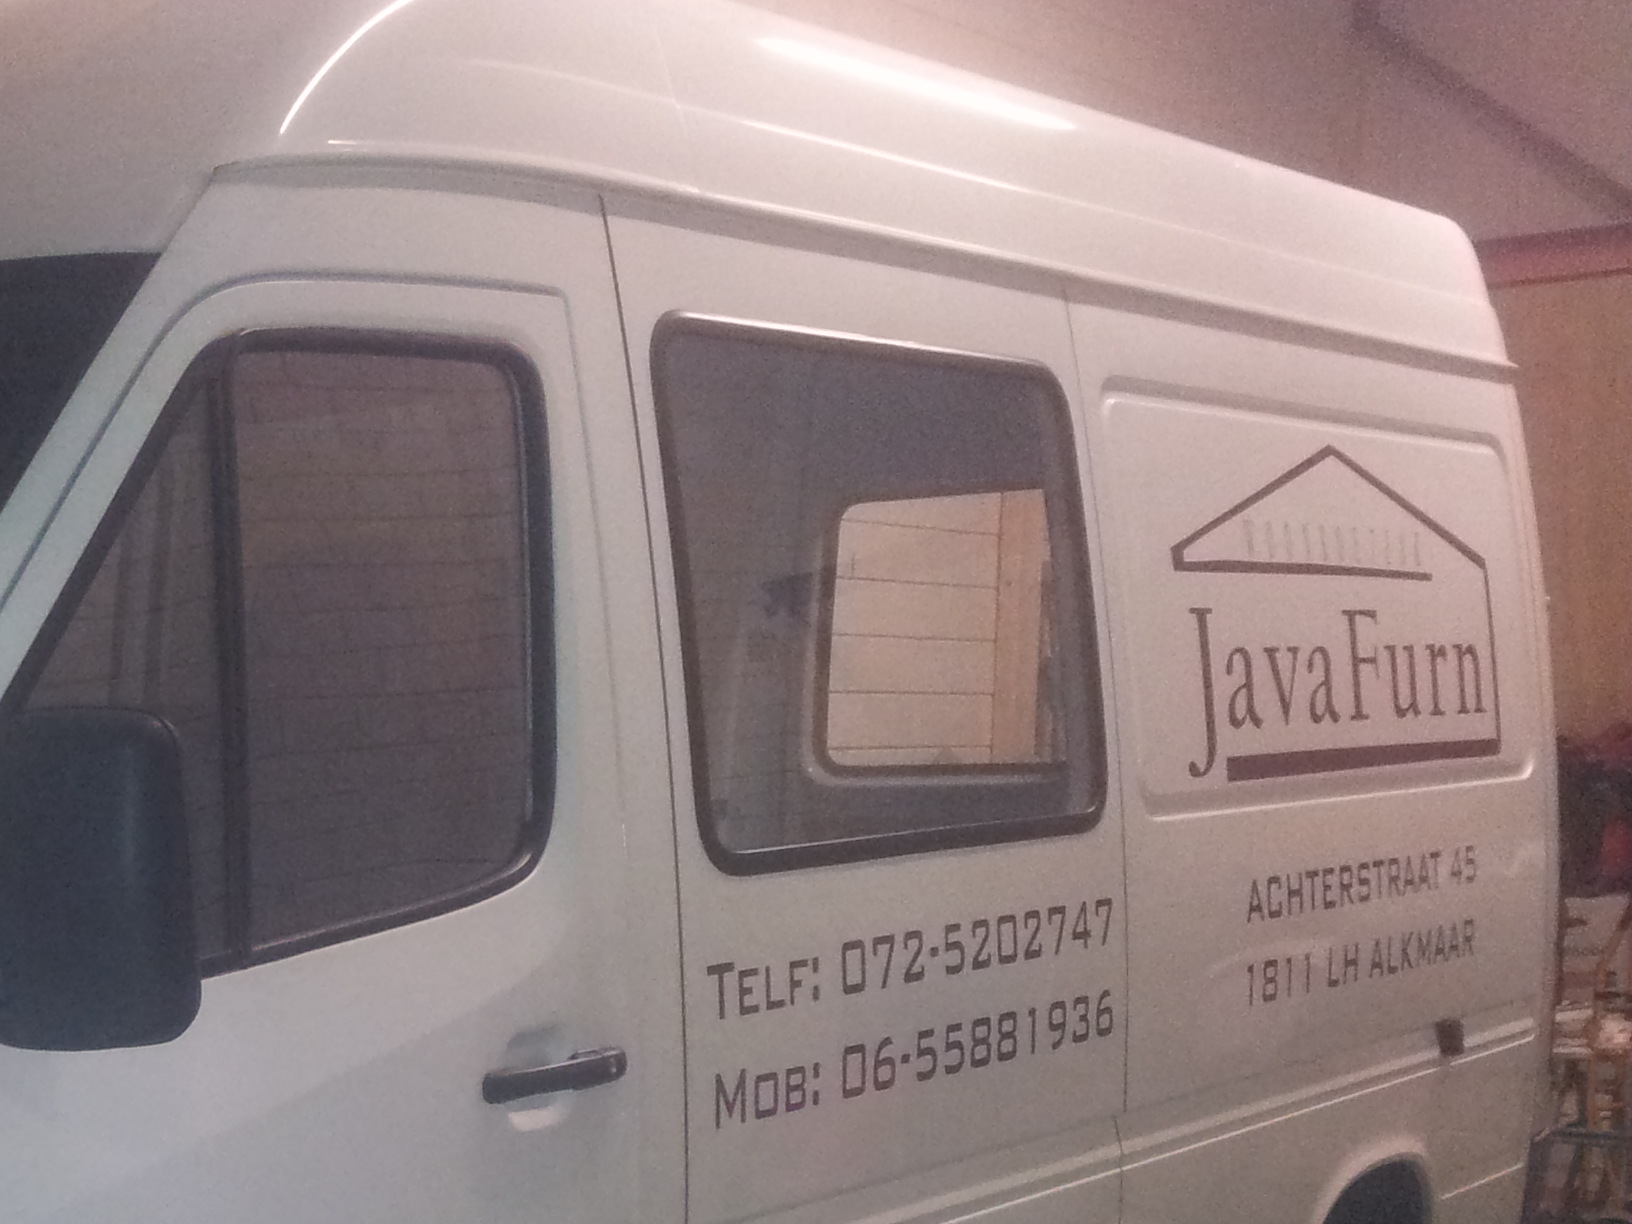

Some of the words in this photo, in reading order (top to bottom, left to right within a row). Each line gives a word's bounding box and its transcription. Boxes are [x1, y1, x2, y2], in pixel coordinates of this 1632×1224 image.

[1188, 607, 1487, 777] JavaFurn
[1247, 851, 1441, 923] ACHTERSTRAAT
[1451, 845, 1477, 884] 45
[841, 897, 1113, 995] 072-5202747
[1247, 953, 1311, 1006] 1811
[1327, 943, 1359, 988] LH
[1369, 918, 1475, 978] ALKMAAR
[841, 988, 1113, 1099] 06-55881936
